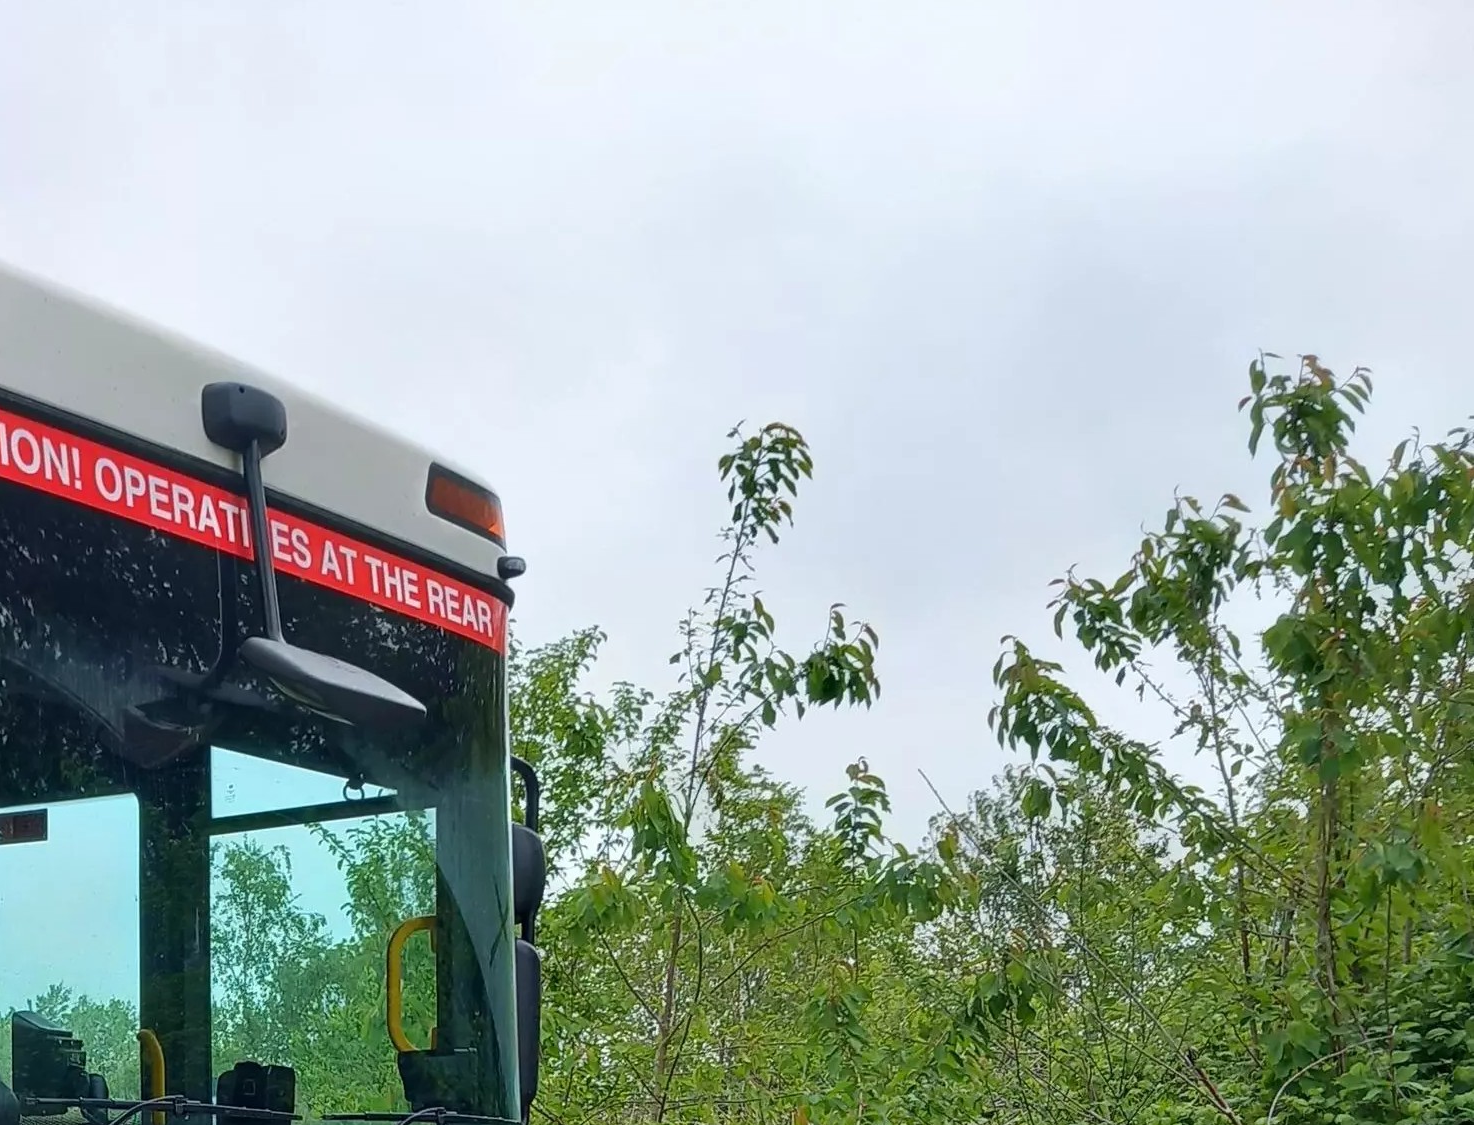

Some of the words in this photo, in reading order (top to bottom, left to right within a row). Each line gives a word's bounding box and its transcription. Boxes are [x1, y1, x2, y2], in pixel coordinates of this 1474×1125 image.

[95, 457, 312, 569] OPERATIES
[320, 545, 357, 585] AT
[365, 556, 420, 609] THE
[427, 577, 494, 638] REAR
